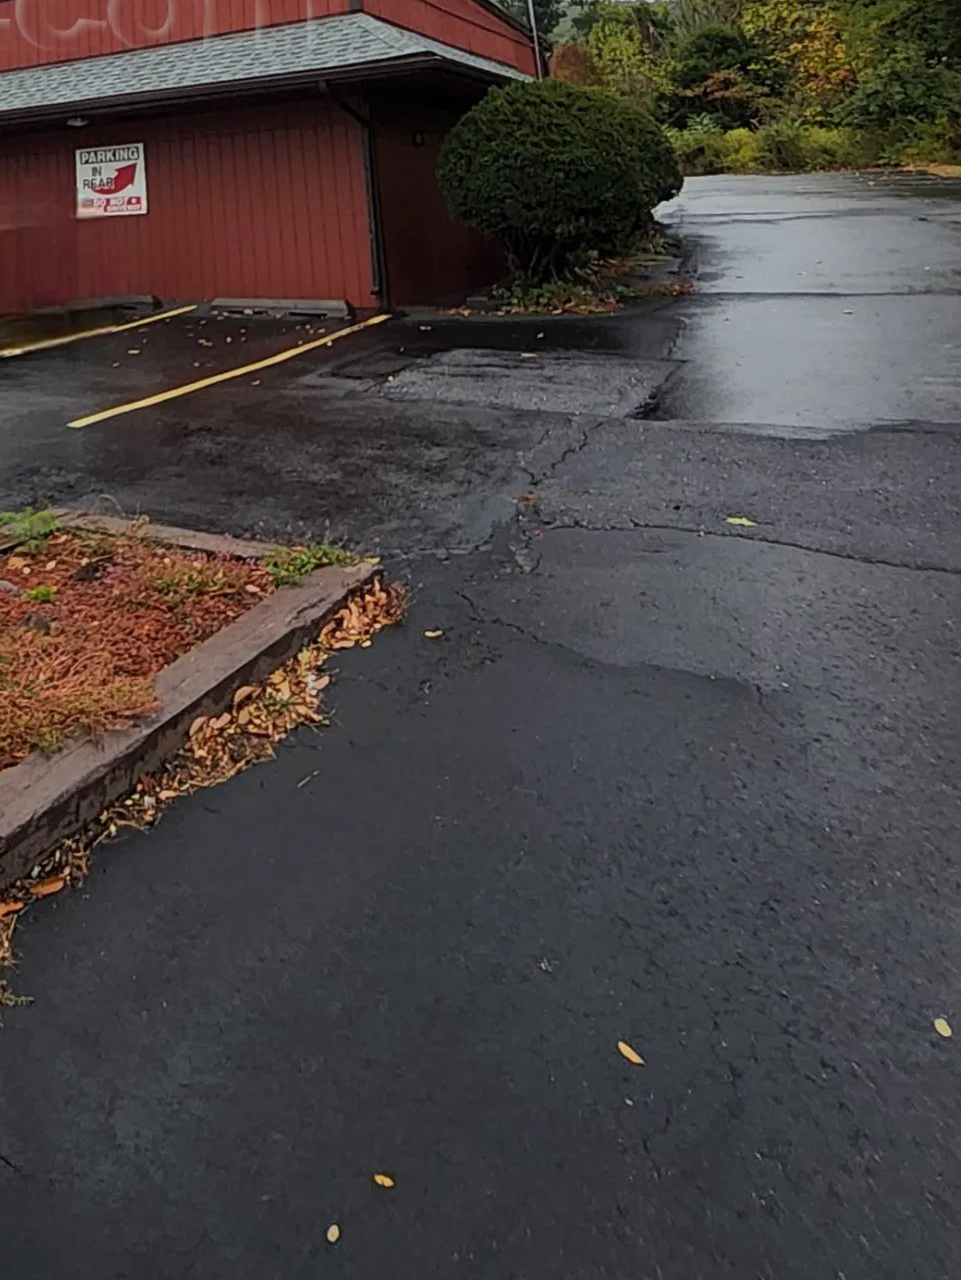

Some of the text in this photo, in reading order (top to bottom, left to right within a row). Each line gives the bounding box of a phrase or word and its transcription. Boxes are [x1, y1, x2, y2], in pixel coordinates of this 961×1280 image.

[81, 147, 138, 164] PARKING
[91, 165, 102, 177] IN
[83, 177, 114, 190] REAR
